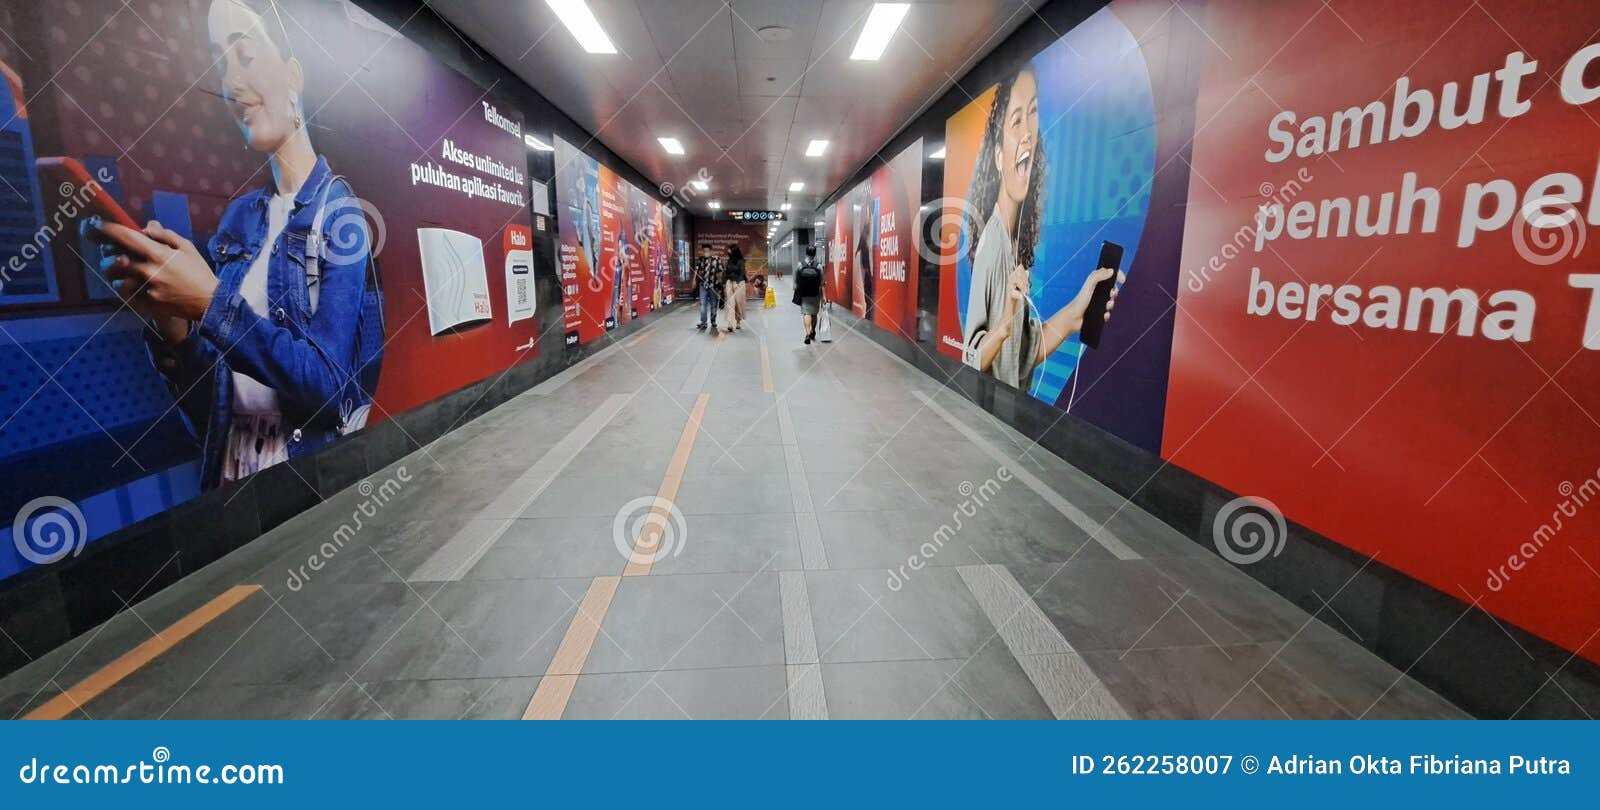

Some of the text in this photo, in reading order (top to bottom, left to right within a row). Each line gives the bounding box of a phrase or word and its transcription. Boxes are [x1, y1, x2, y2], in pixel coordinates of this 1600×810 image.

[482, 100, 522, 138] Telkomsel
[1264, 51, 1538, 163] Sambut
[442, 138, 475, 168] Akses
[475, 156, 514, 182] unlimited
[411, 162, 461, 191] puluhan
[462, 176, 497, 199] aplikasi
[881, 211, 896, 234] BUKA
[1254, 172, 1441, 252] penuh
[510, 230, 526, 246] Halo
[880, 235, 899, 257] SEMUA
[880, 261, 906, 282] PELUANG
[1247, 267, 1536, 343] bersama
